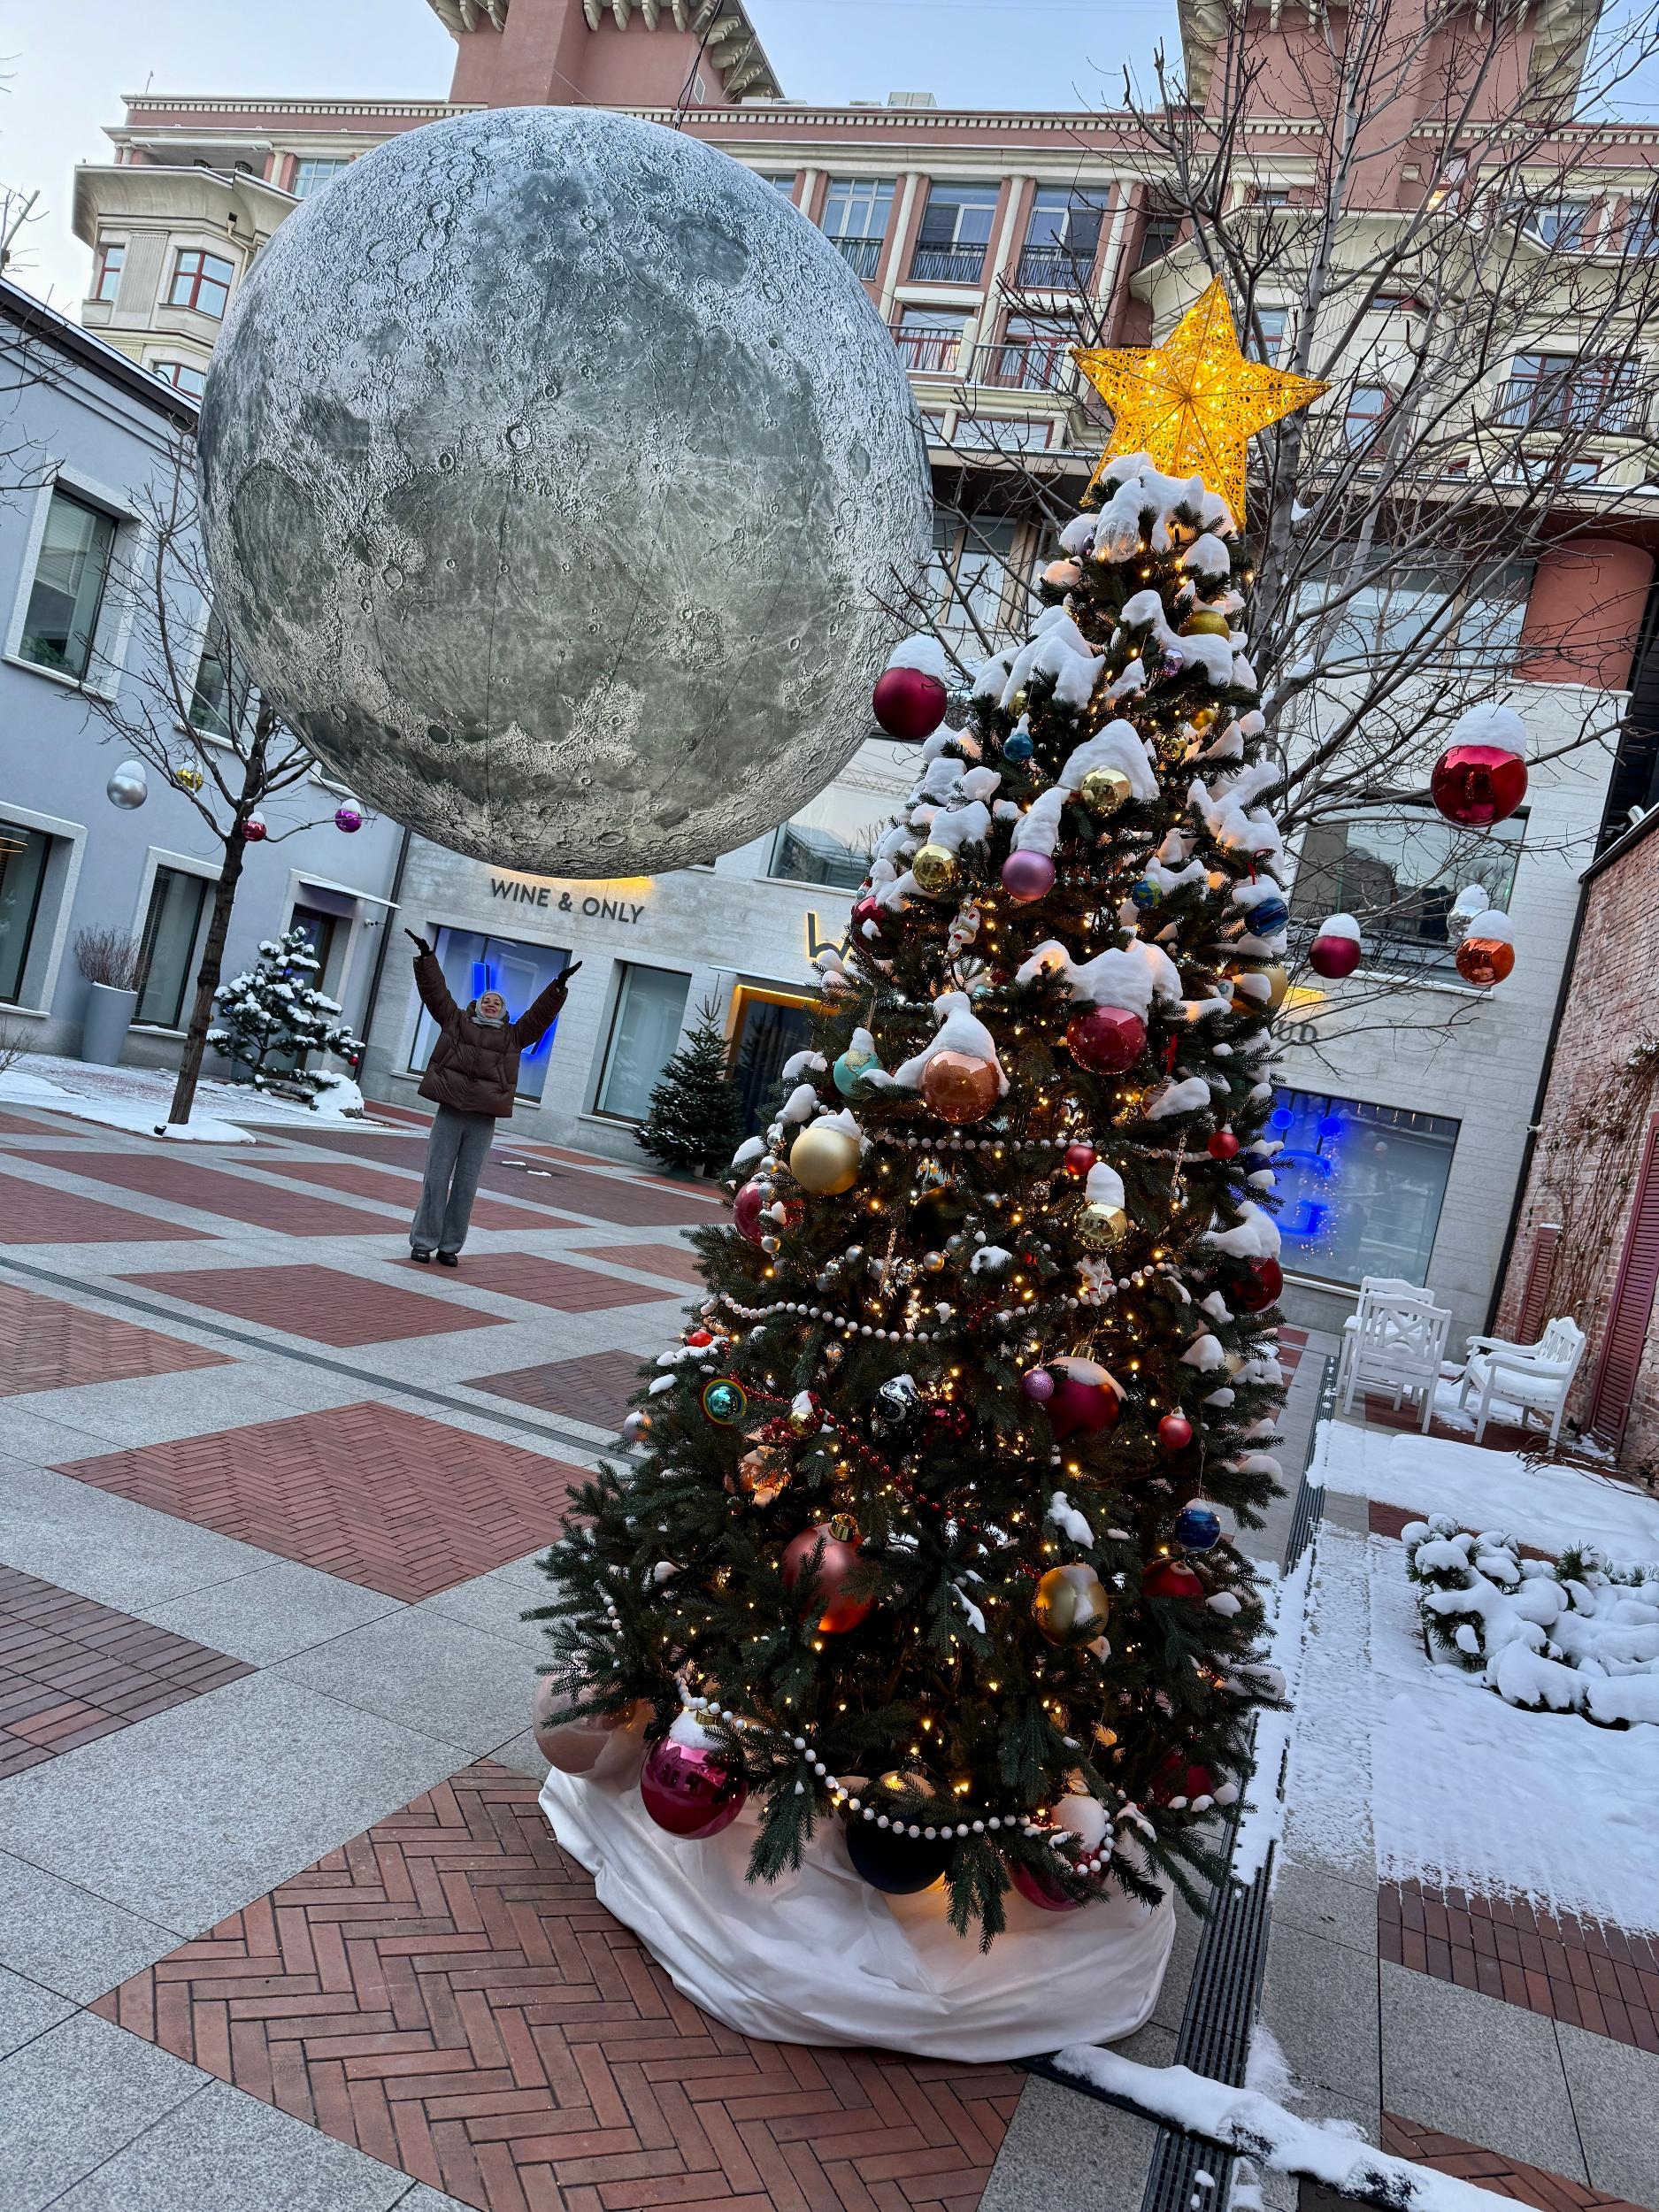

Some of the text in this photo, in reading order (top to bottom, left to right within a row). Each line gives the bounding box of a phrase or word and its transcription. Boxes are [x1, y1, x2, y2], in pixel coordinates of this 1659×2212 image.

[491, 878, 645, 924] WINE & ONLY
